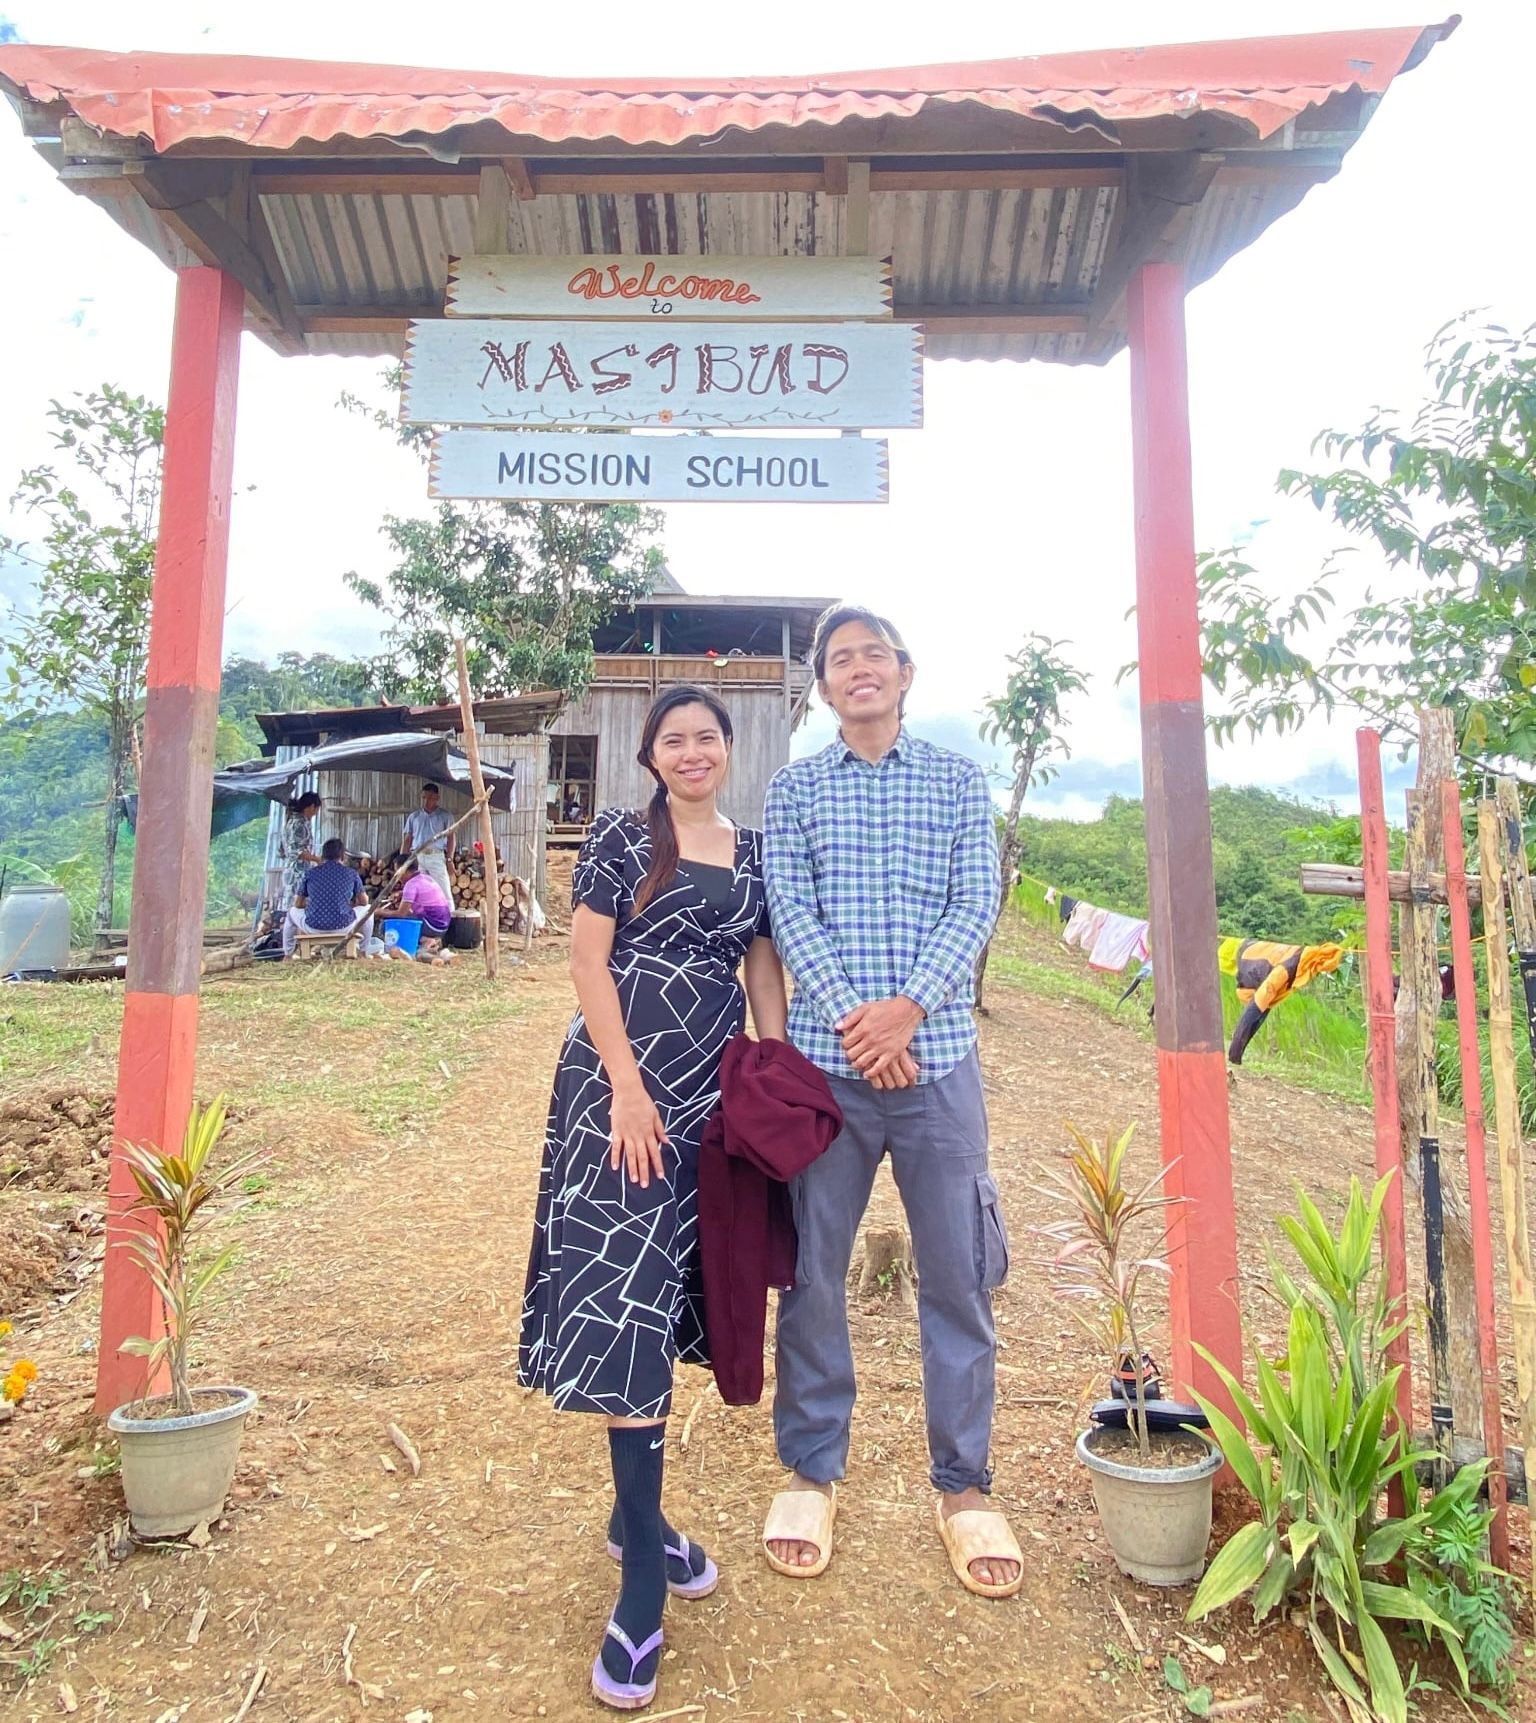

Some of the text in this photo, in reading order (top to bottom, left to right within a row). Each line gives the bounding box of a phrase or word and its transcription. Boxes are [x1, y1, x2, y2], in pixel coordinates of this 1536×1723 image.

[568, 262, 760, 303] Welcome
[651, 298, 673, 315] to
[498, 451, 829, 488] MISSION SCHOOL
